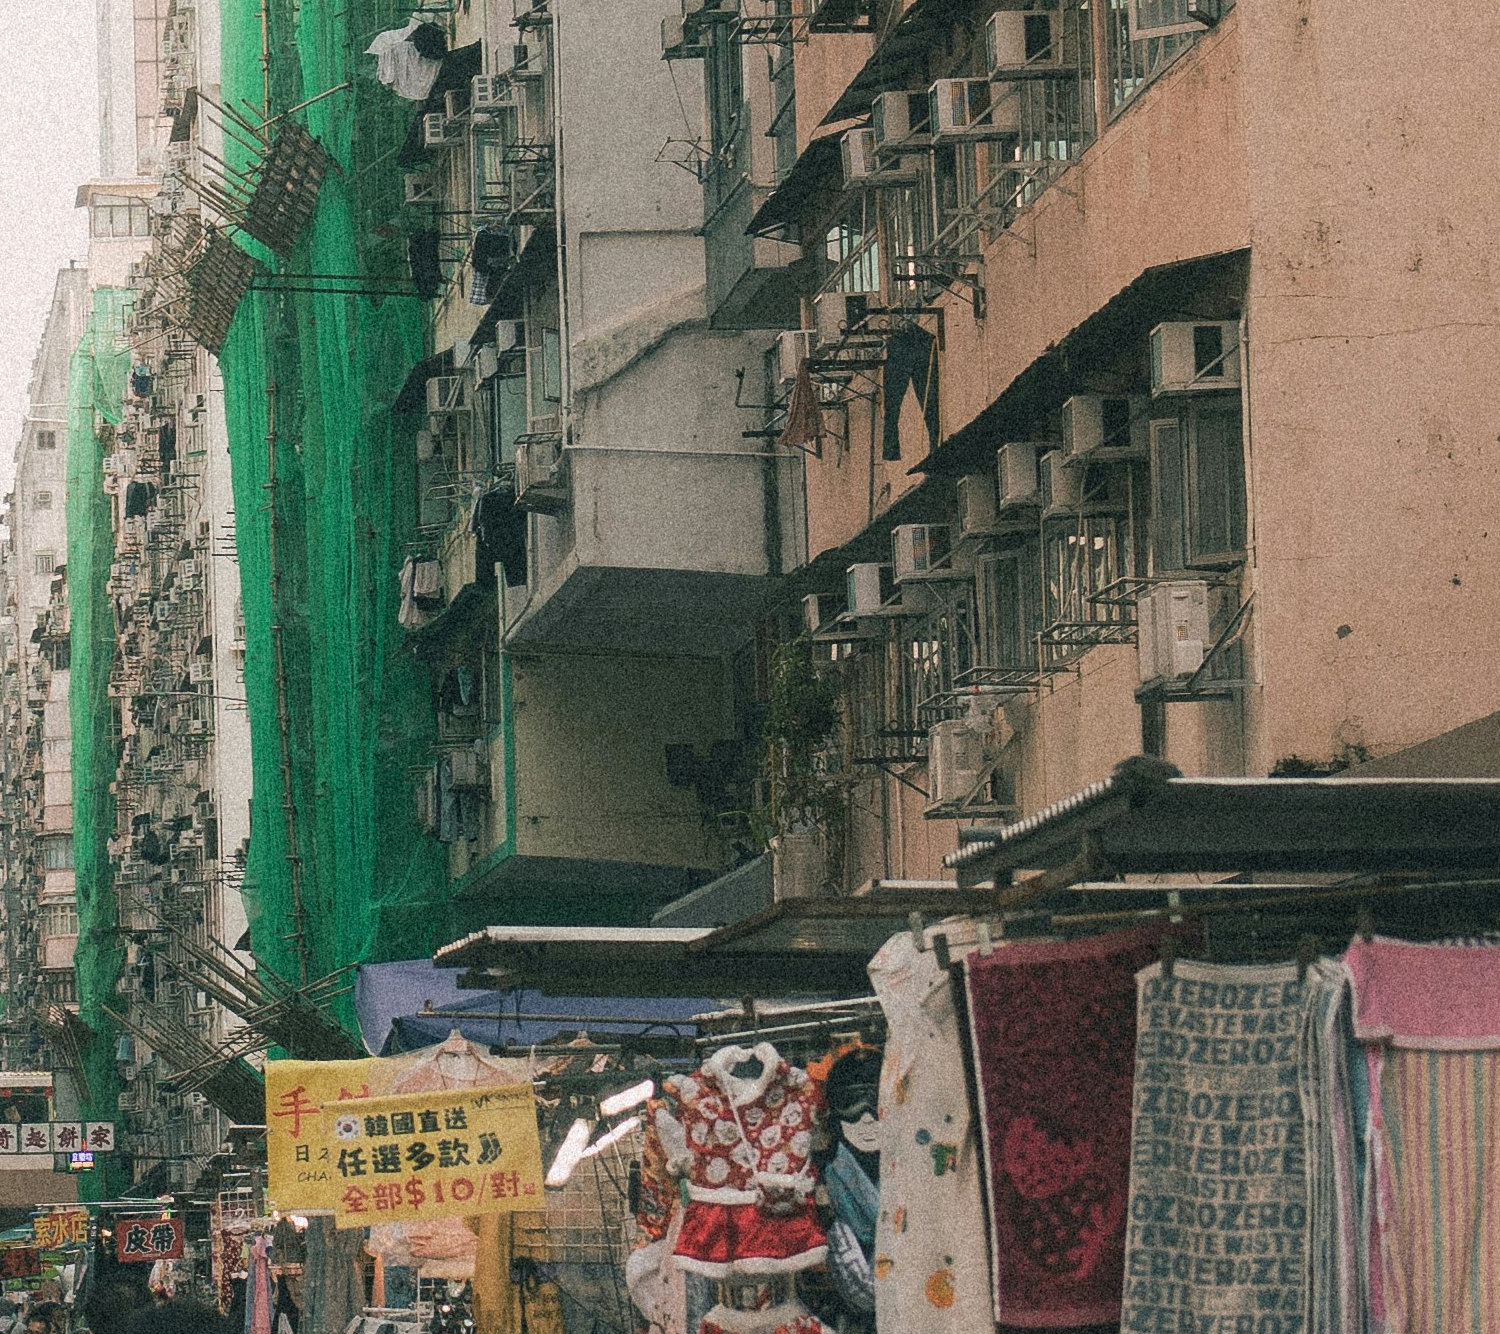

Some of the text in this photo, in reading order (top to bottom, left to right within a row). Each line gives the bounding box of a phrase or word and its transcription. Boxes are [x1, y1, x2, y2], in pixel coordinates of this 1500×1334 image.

[362, 1107, 469, 1139] 韓國直送
[337, 1138, 471, 1179] 任選多款
[123, 1222, 176, 1254] 皮帶
